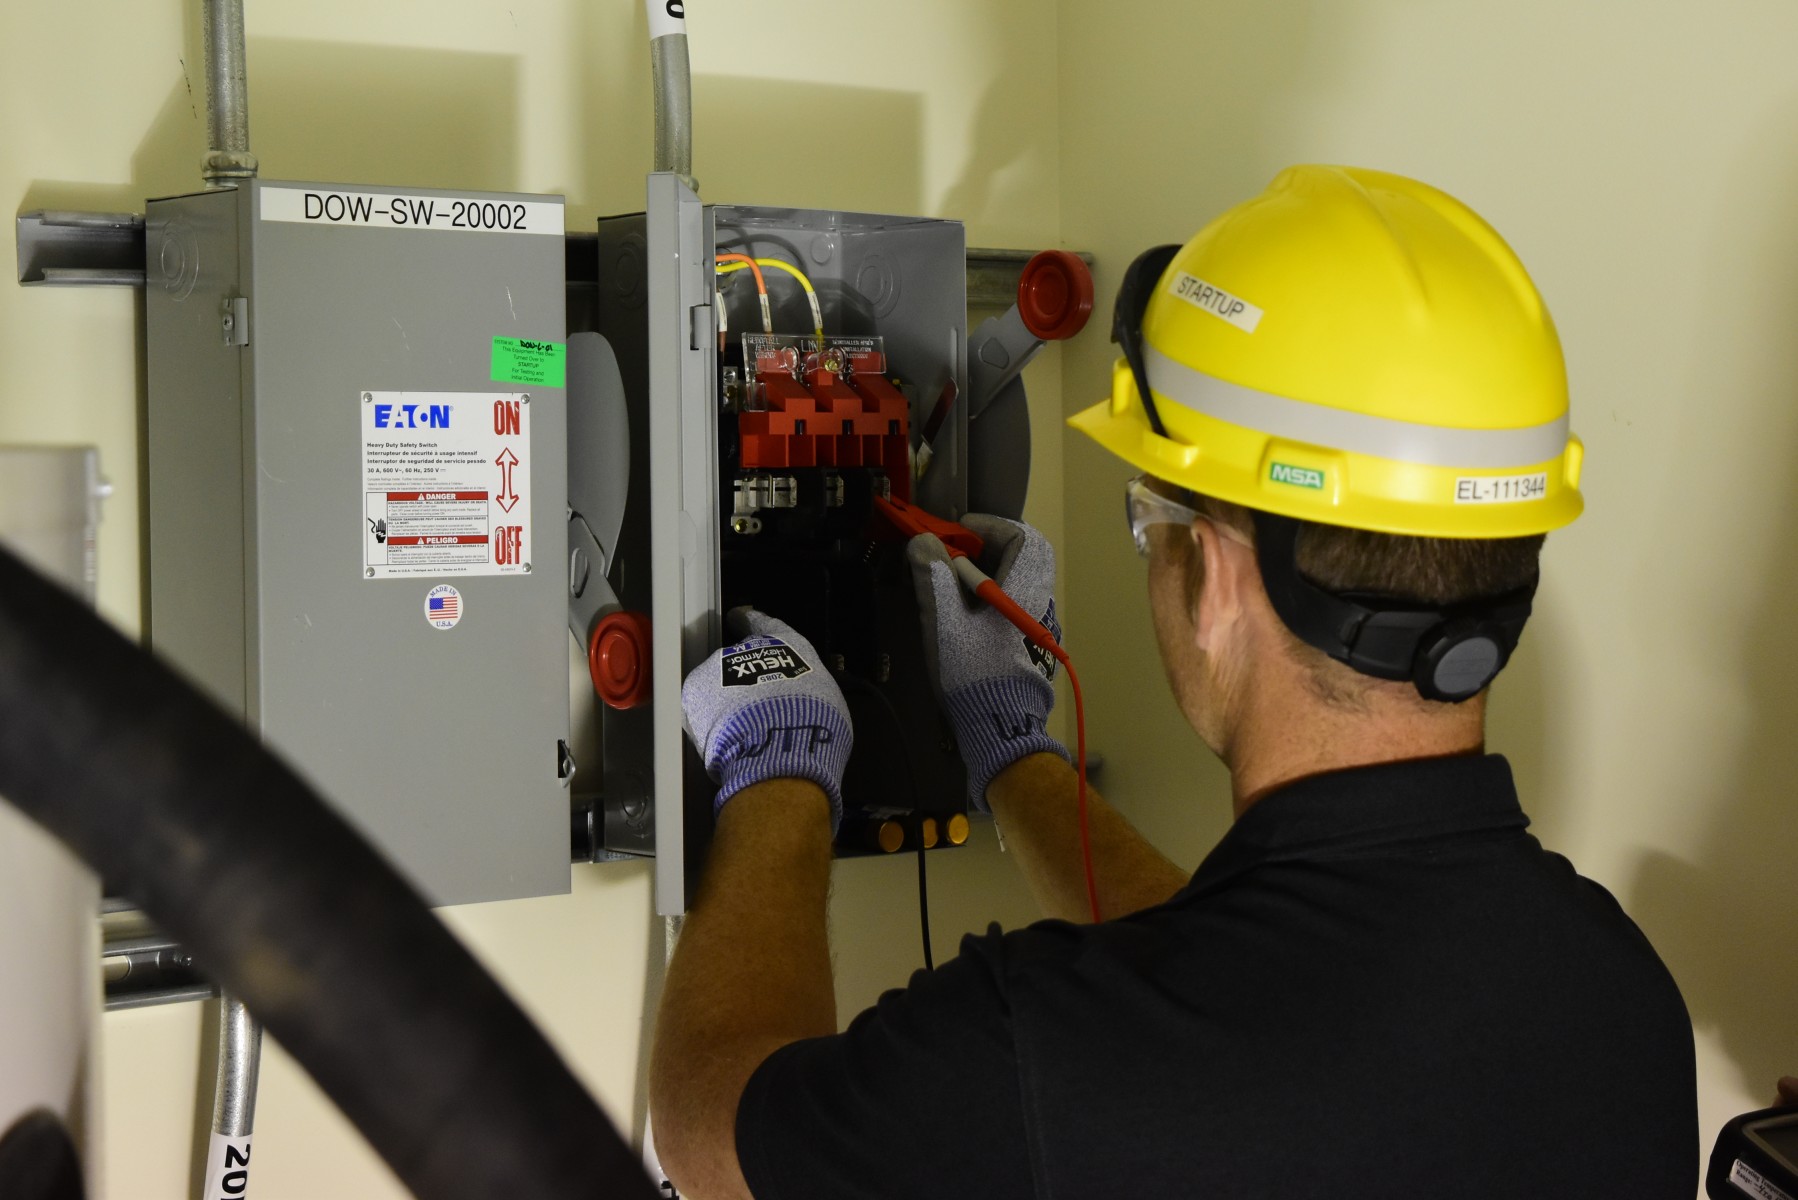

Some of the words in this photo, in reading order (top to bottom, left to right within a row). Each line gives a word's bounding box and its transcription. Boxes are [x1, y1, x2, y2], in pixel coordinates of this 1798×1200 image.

[304, 193, 527, 230] DOW-SW-20002
[1177, 276, 1245, 317] STARTUP
[374, 404, 450, 428] EATON
[494, 400, 520, 436] ON
[1272, 463, 1322, 488] MSA
[1458, 476, 1544, 500] EL-111344
[495, 526, 522, 566] OFF
[430, 586, 448, 598] MADE
[449, 588, 457, 596] IN
[731, 648, 786, 665] HexArmor
[732, 655, 796, 678] HELIX
[760, 673, 784, 683] 2085
